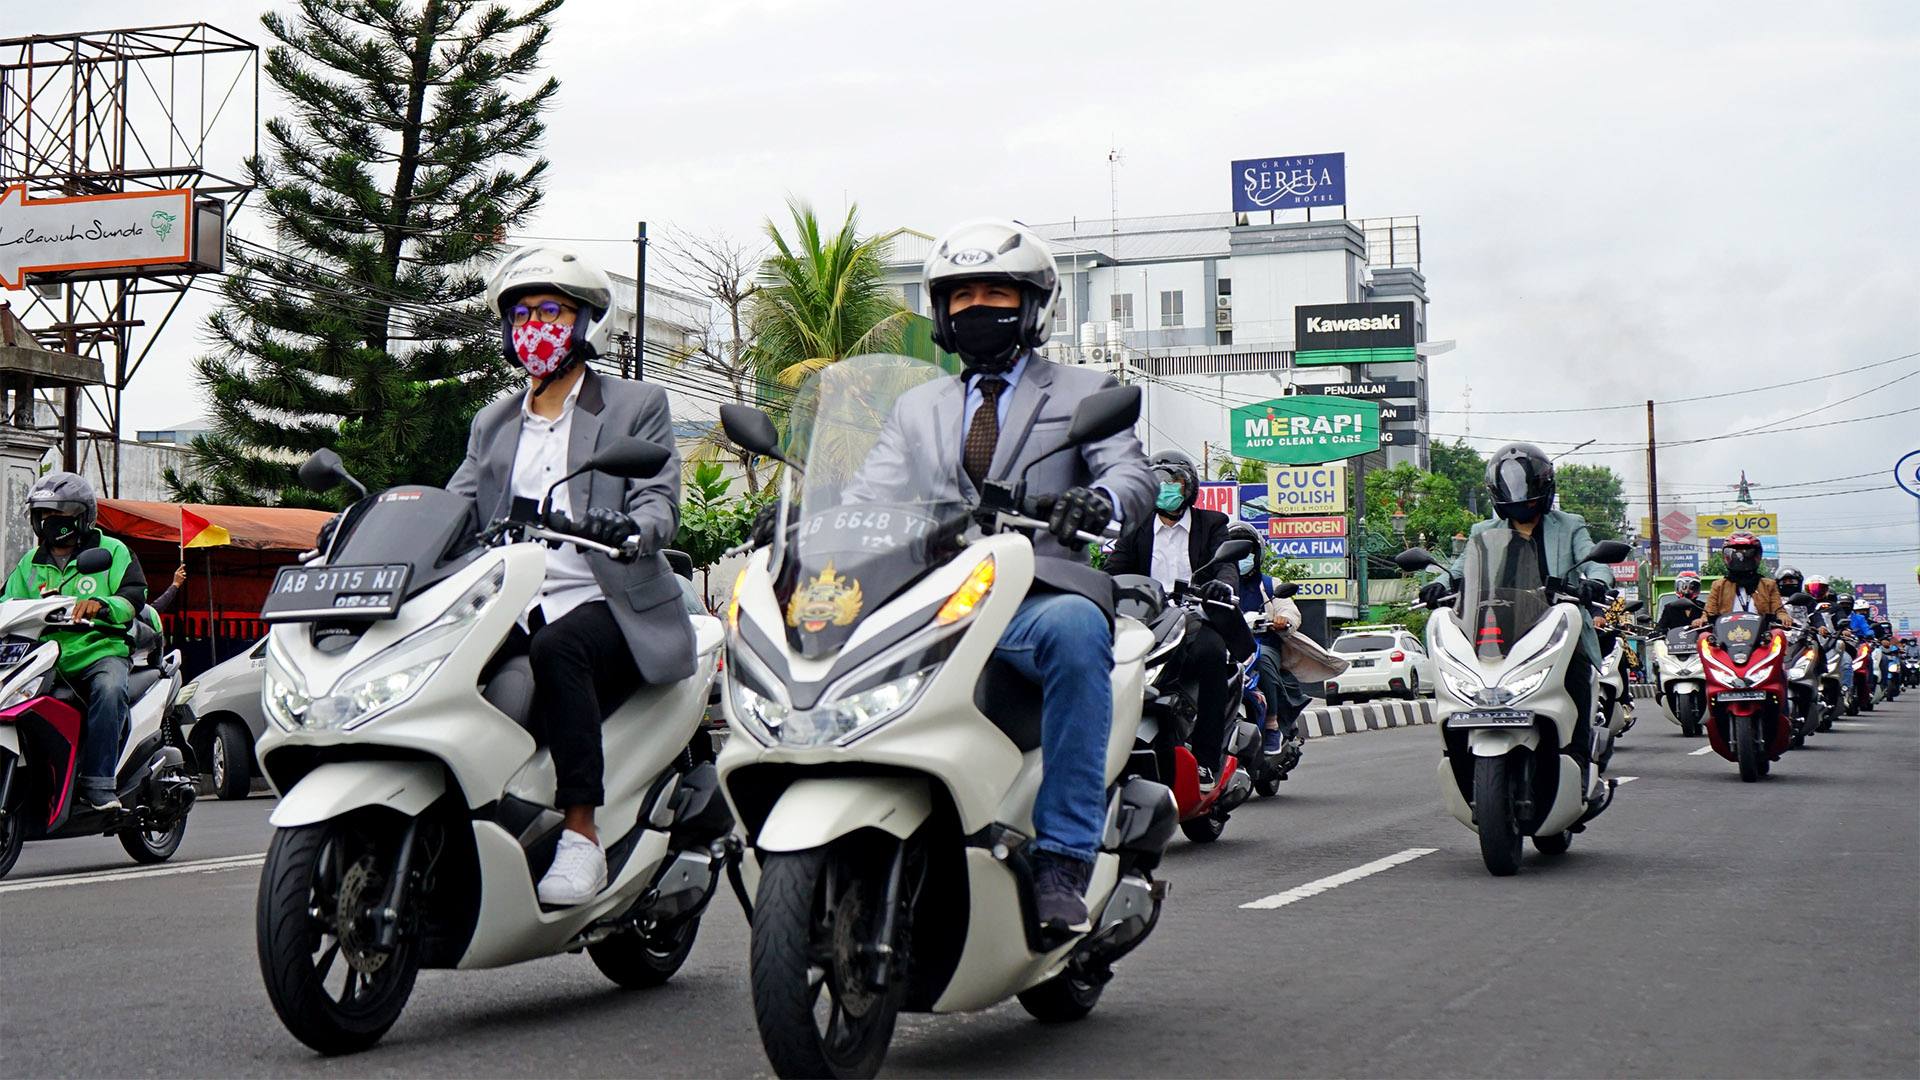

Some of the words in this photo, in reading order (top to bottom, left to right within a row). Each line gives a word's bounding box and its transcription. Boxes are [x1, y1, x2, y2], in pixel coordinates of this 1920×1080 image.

[1261, 158, 1315, 169] GRAND
[1244, 167, 1333, 196] SERELA
[1294, 193, 1334, 203] HOTEL
[85, 219, 144, 240] Sunda
[1306, 313, 1401, 333] Kawasaki
[1324, 384, 1386, 396] PENJUALAN
[1245, 412, 1363, 438] MERAPI
[1246, 438, 1274, 448] AUTO
[1279, 437, 1314, 446] CLEAN
[1318, 436, 1327, 444] &
[1332, 435, 1361, 443] CARE
[1276, 470, 1335, 489] CUCI
[1195, 488, 1233, 515] RAPI
[1278, 490, 1335, 505] POLISH
[834, 511, 891, 530] 6648
[1272, 520, 1341, 534] NITROGEN
[1734, 517, 1770, 529] UFO
[1271, 542, 1308, 555] KACA
[1311, 541, 1343, 554] FILM
[1316, 562, 1343, 574] JOK
[281, 573, 309, 593] AB
[314, 570, 364, 591] 3115
[372, 570, 397, 589] NI
[1297, 583, 1338, 595] ESORI
